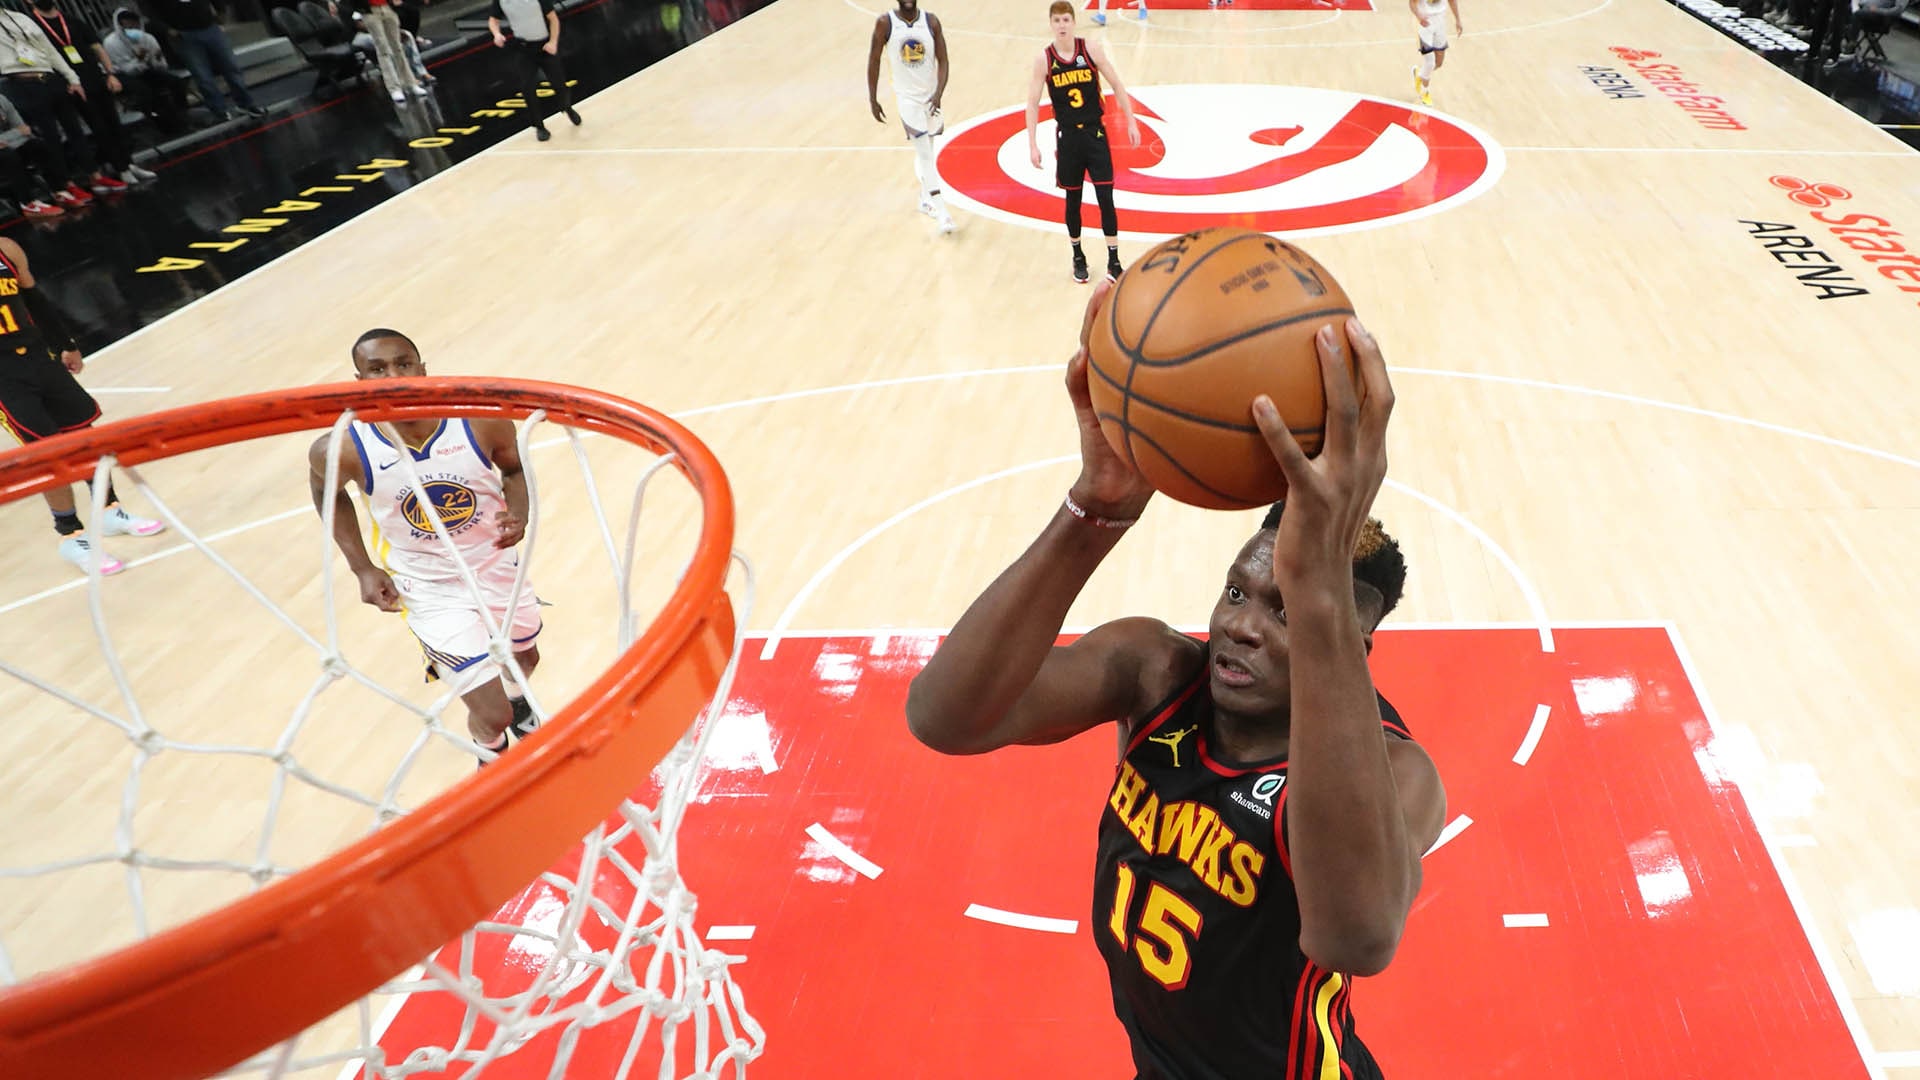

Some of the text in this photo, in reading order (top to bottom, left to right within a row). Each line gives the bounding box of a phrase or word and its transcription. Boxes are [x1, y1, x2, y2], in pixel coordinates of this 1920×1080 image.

[1052, 69, 1092, 87] HAWKS
[1577, 66, 1646, 99] ARENA
[1067, 87, 1084, 108] 3
[408, 125, 481, 148] TO
[135, 158, 409, 273] ATLANTA
[1738, 219, 1870, 300] ARENA
[396, 472, 470, 501] GOLEN STATE
[442, 490, 469, 507] 22
[1230, 791, 1271, 820] sharecare
[1109, 760, 1266, 907] HAWKS
[1108, 861, 1203, 991] 15
